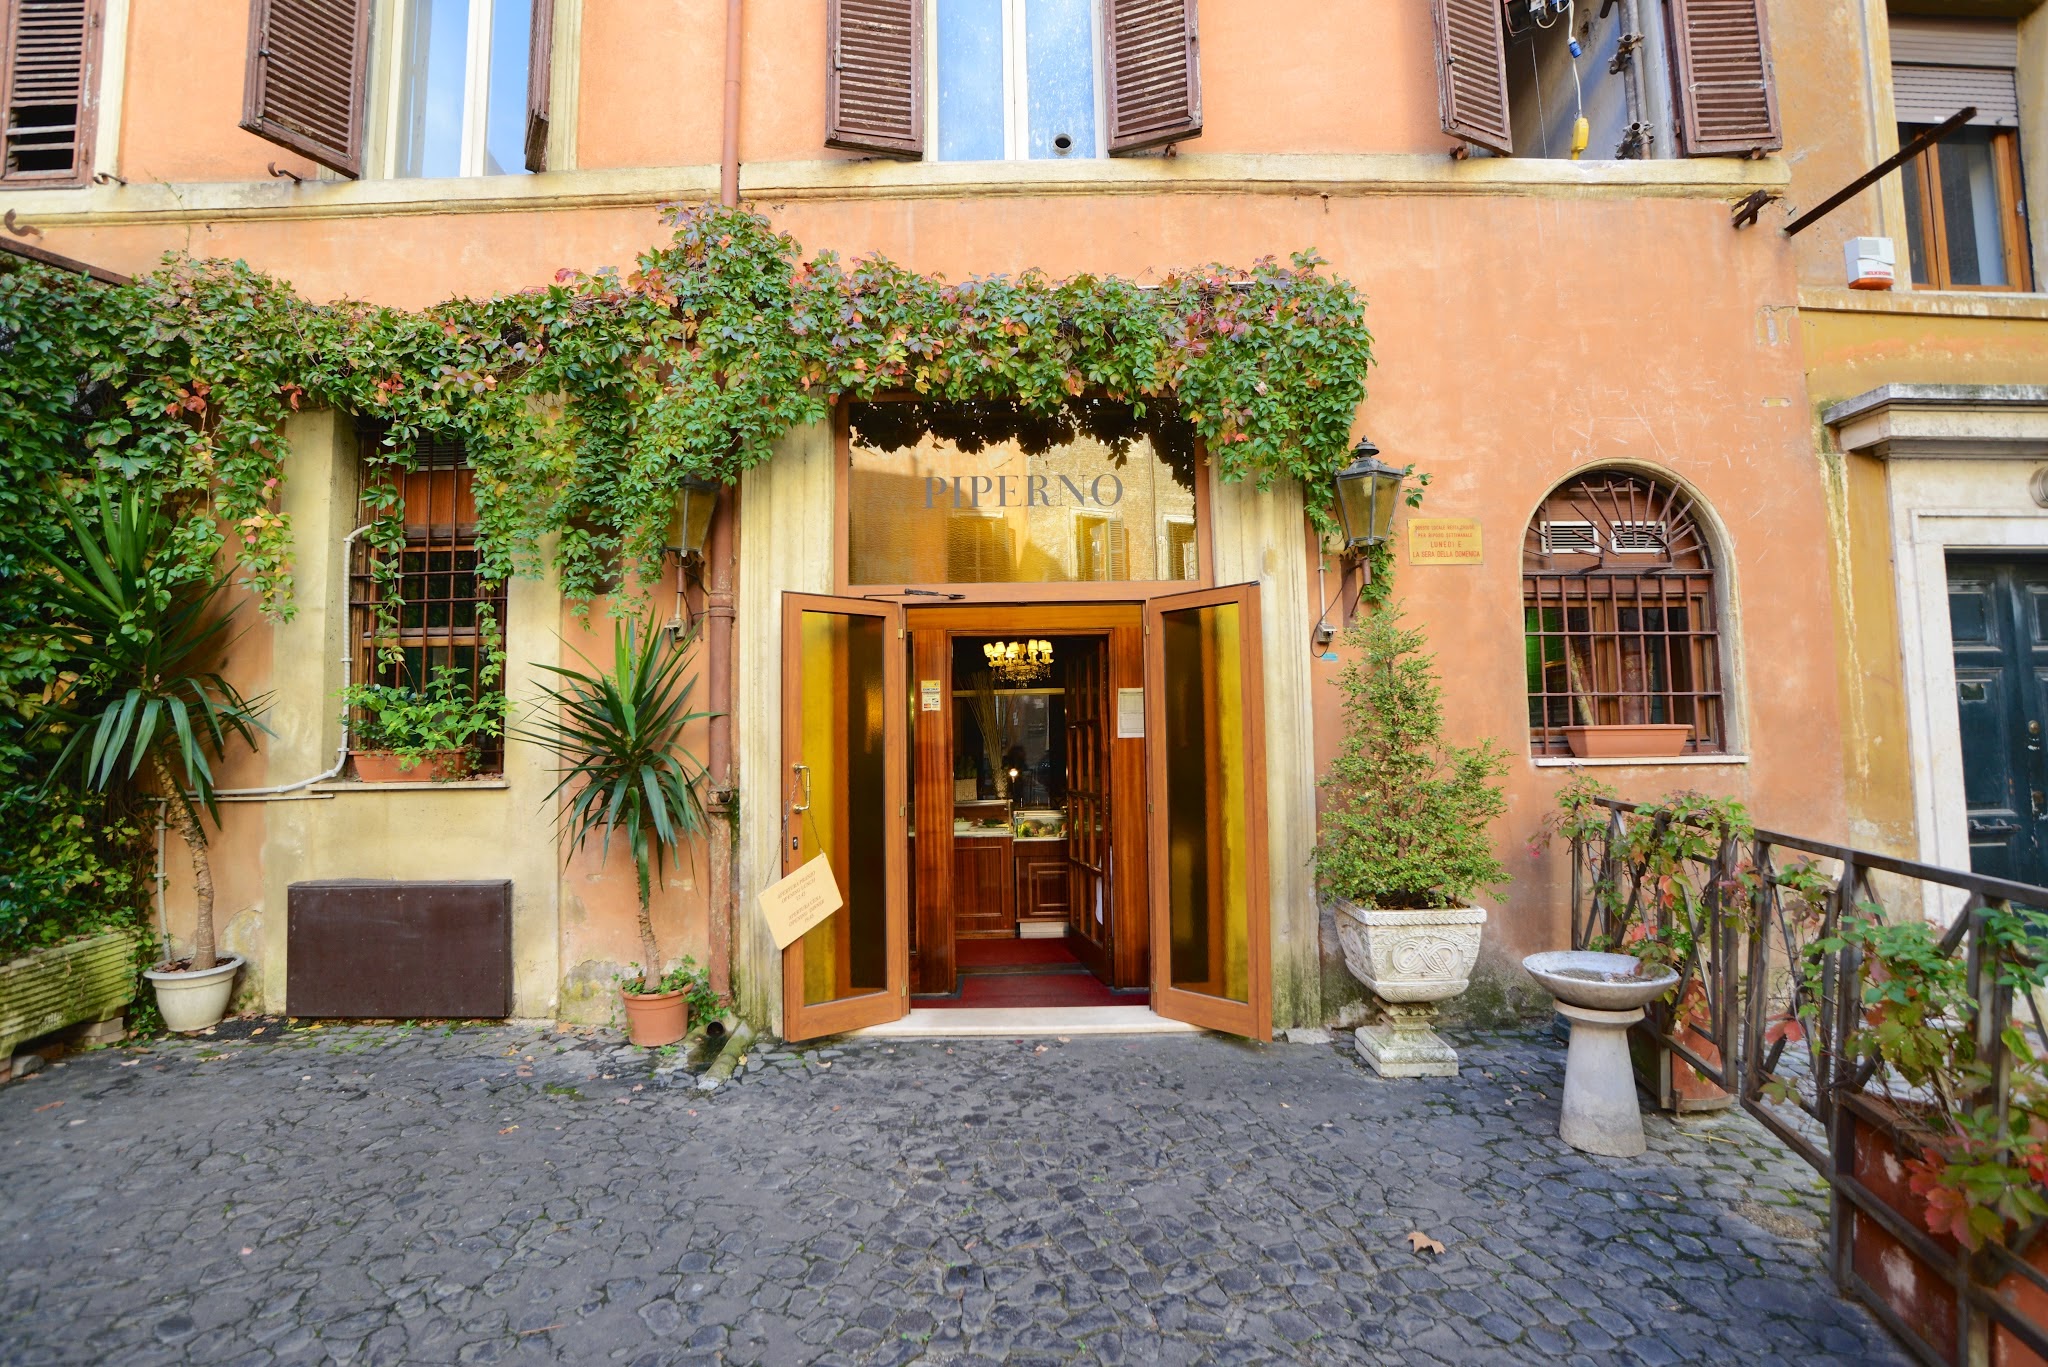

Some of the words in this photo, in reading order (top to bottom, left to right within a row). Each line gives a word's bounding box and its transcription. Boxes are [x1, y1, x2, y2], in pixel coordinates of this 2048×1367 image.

[924, 473, 1123, 508] PIPERNO
[1422, 550, 1435, 558] SERA
[1437, 550, 1453, 558] DELLA
[1455, 550, 1480, 558] DOMENICA
[778, 881, 799, 899] APERTURA
[782, 888, 800, 903] OPENING
[801, 877, 816, 890] LUNCH
[789, 902, 809, 920] APERTURA
[789, 911, 808, 927] OPENING
